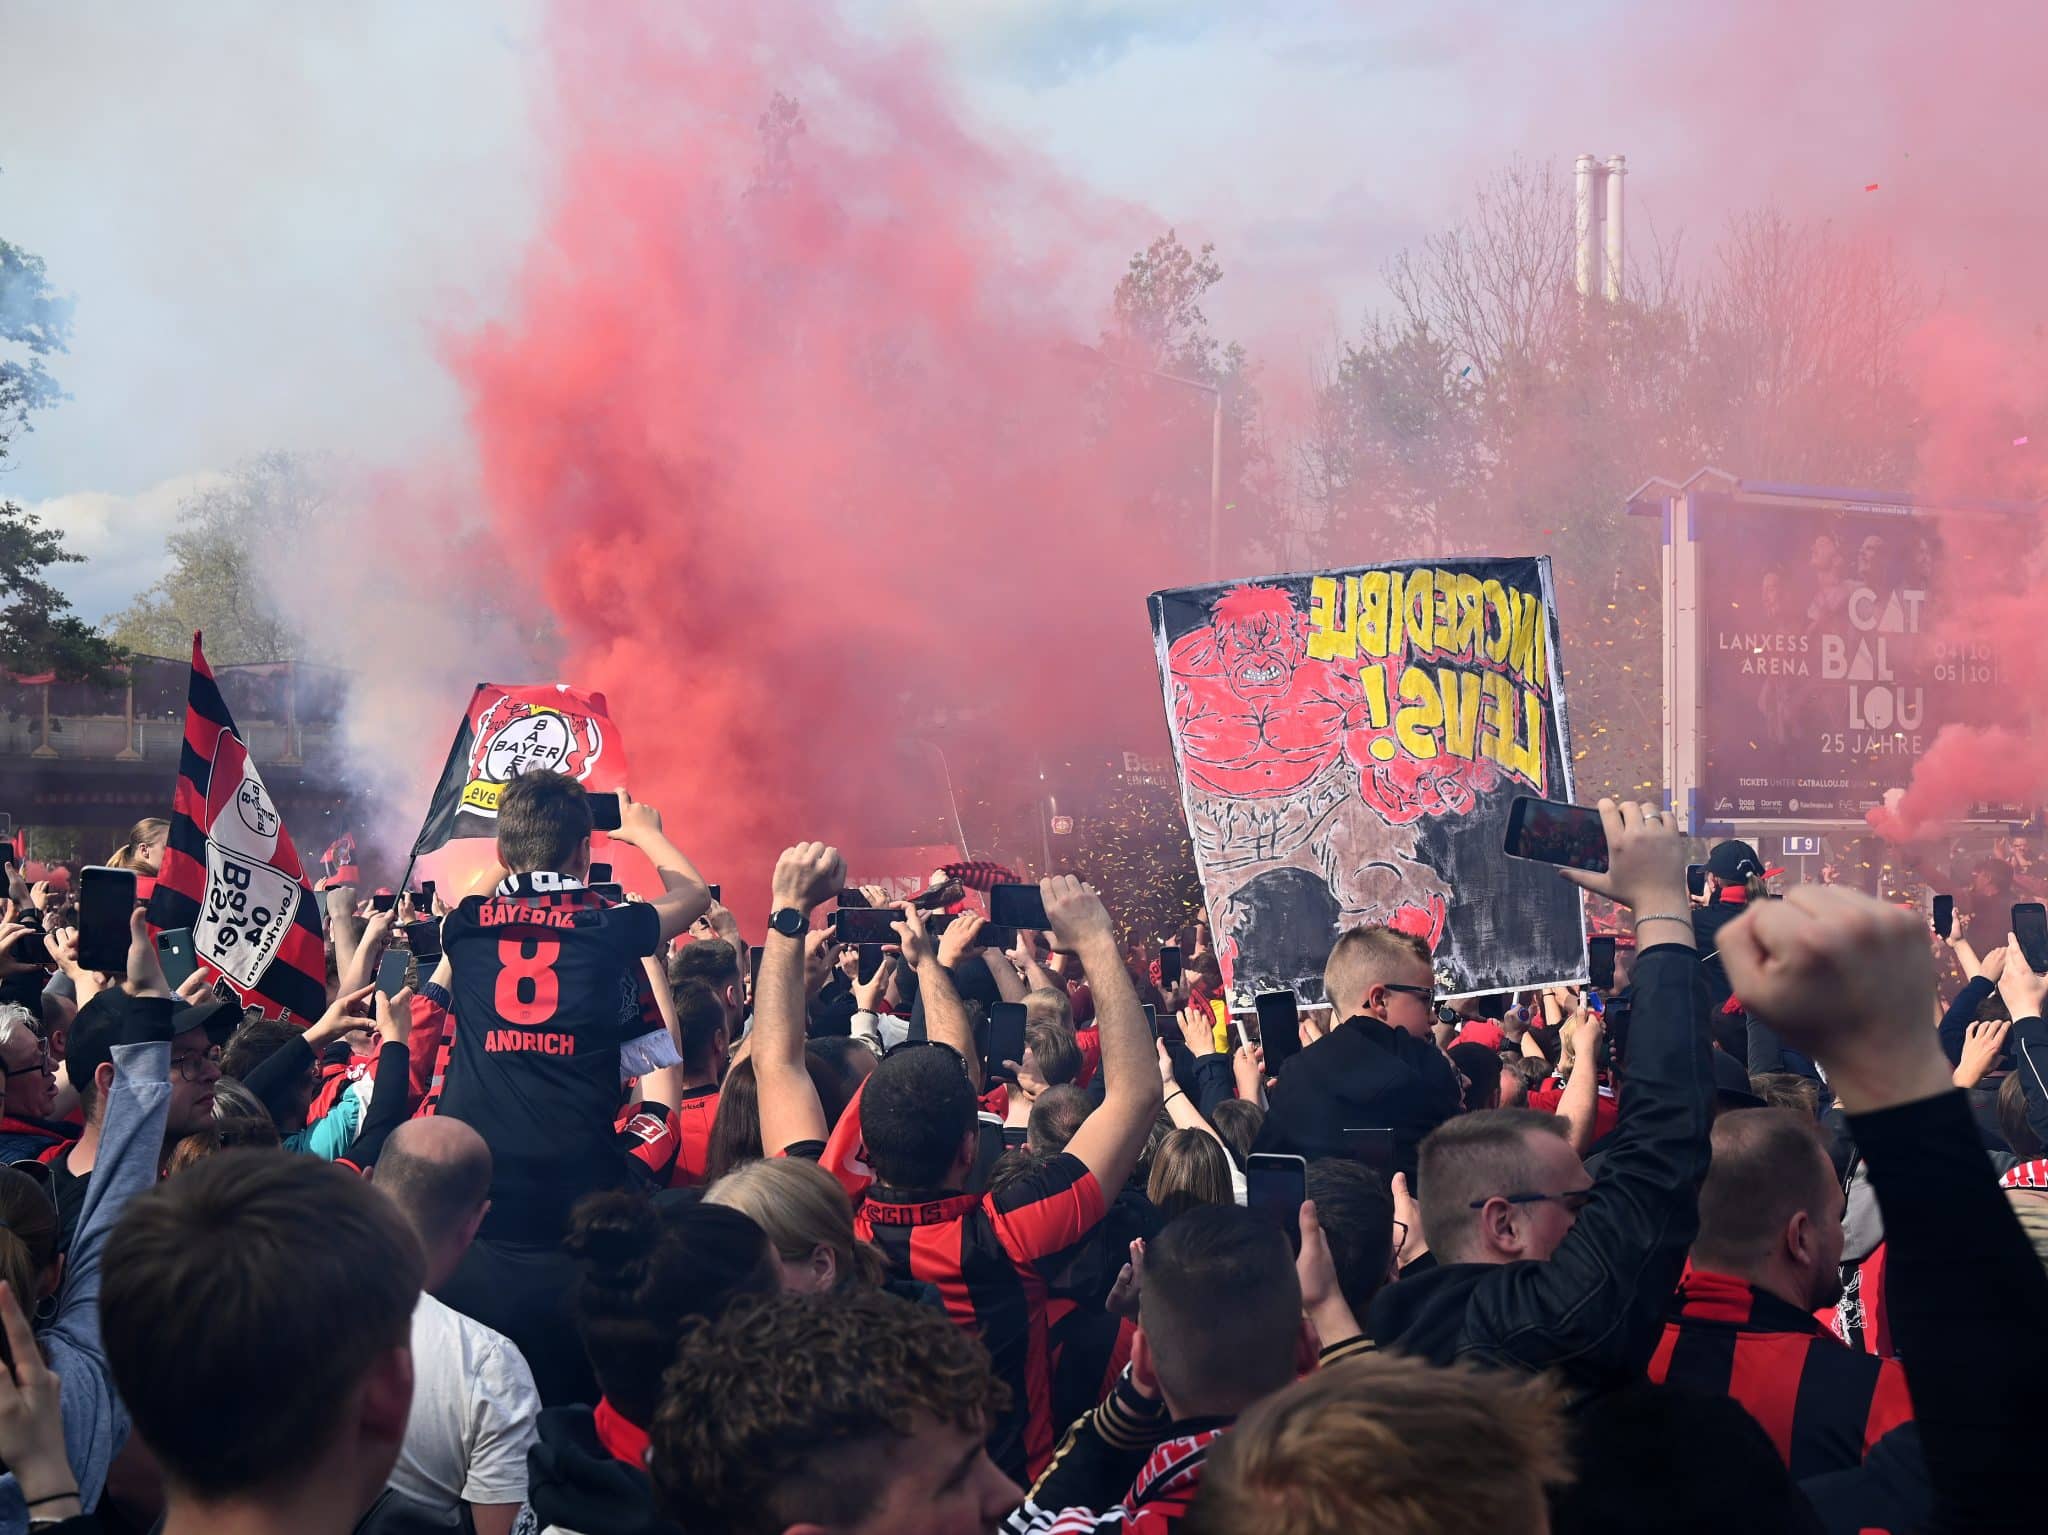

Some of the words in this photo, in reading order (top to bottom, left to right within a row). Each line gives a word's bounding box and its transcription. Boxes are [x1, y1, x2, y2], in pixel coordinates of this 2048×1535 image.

[1848, 587, 1925, 632] CAT
[1719, 632, 1809, 652] LANXESS
[1741, 658, 1810, 676] ARENA
[1822, 634, 1894, 681] BAL
[1850, 685, 1924, 730] LOU
[494, 740, 560, 760] BAYER
[1821, 733, 1845, 753] 25
[1851, 734, 1922, 754] JAHRE
[1739, 778, 1769, 787] TICKETS
[1804, 838, 1813, 850] 9
[494, 926, 561, 1025] 8
[485, 1029, 576, 1056] ANDRICH
